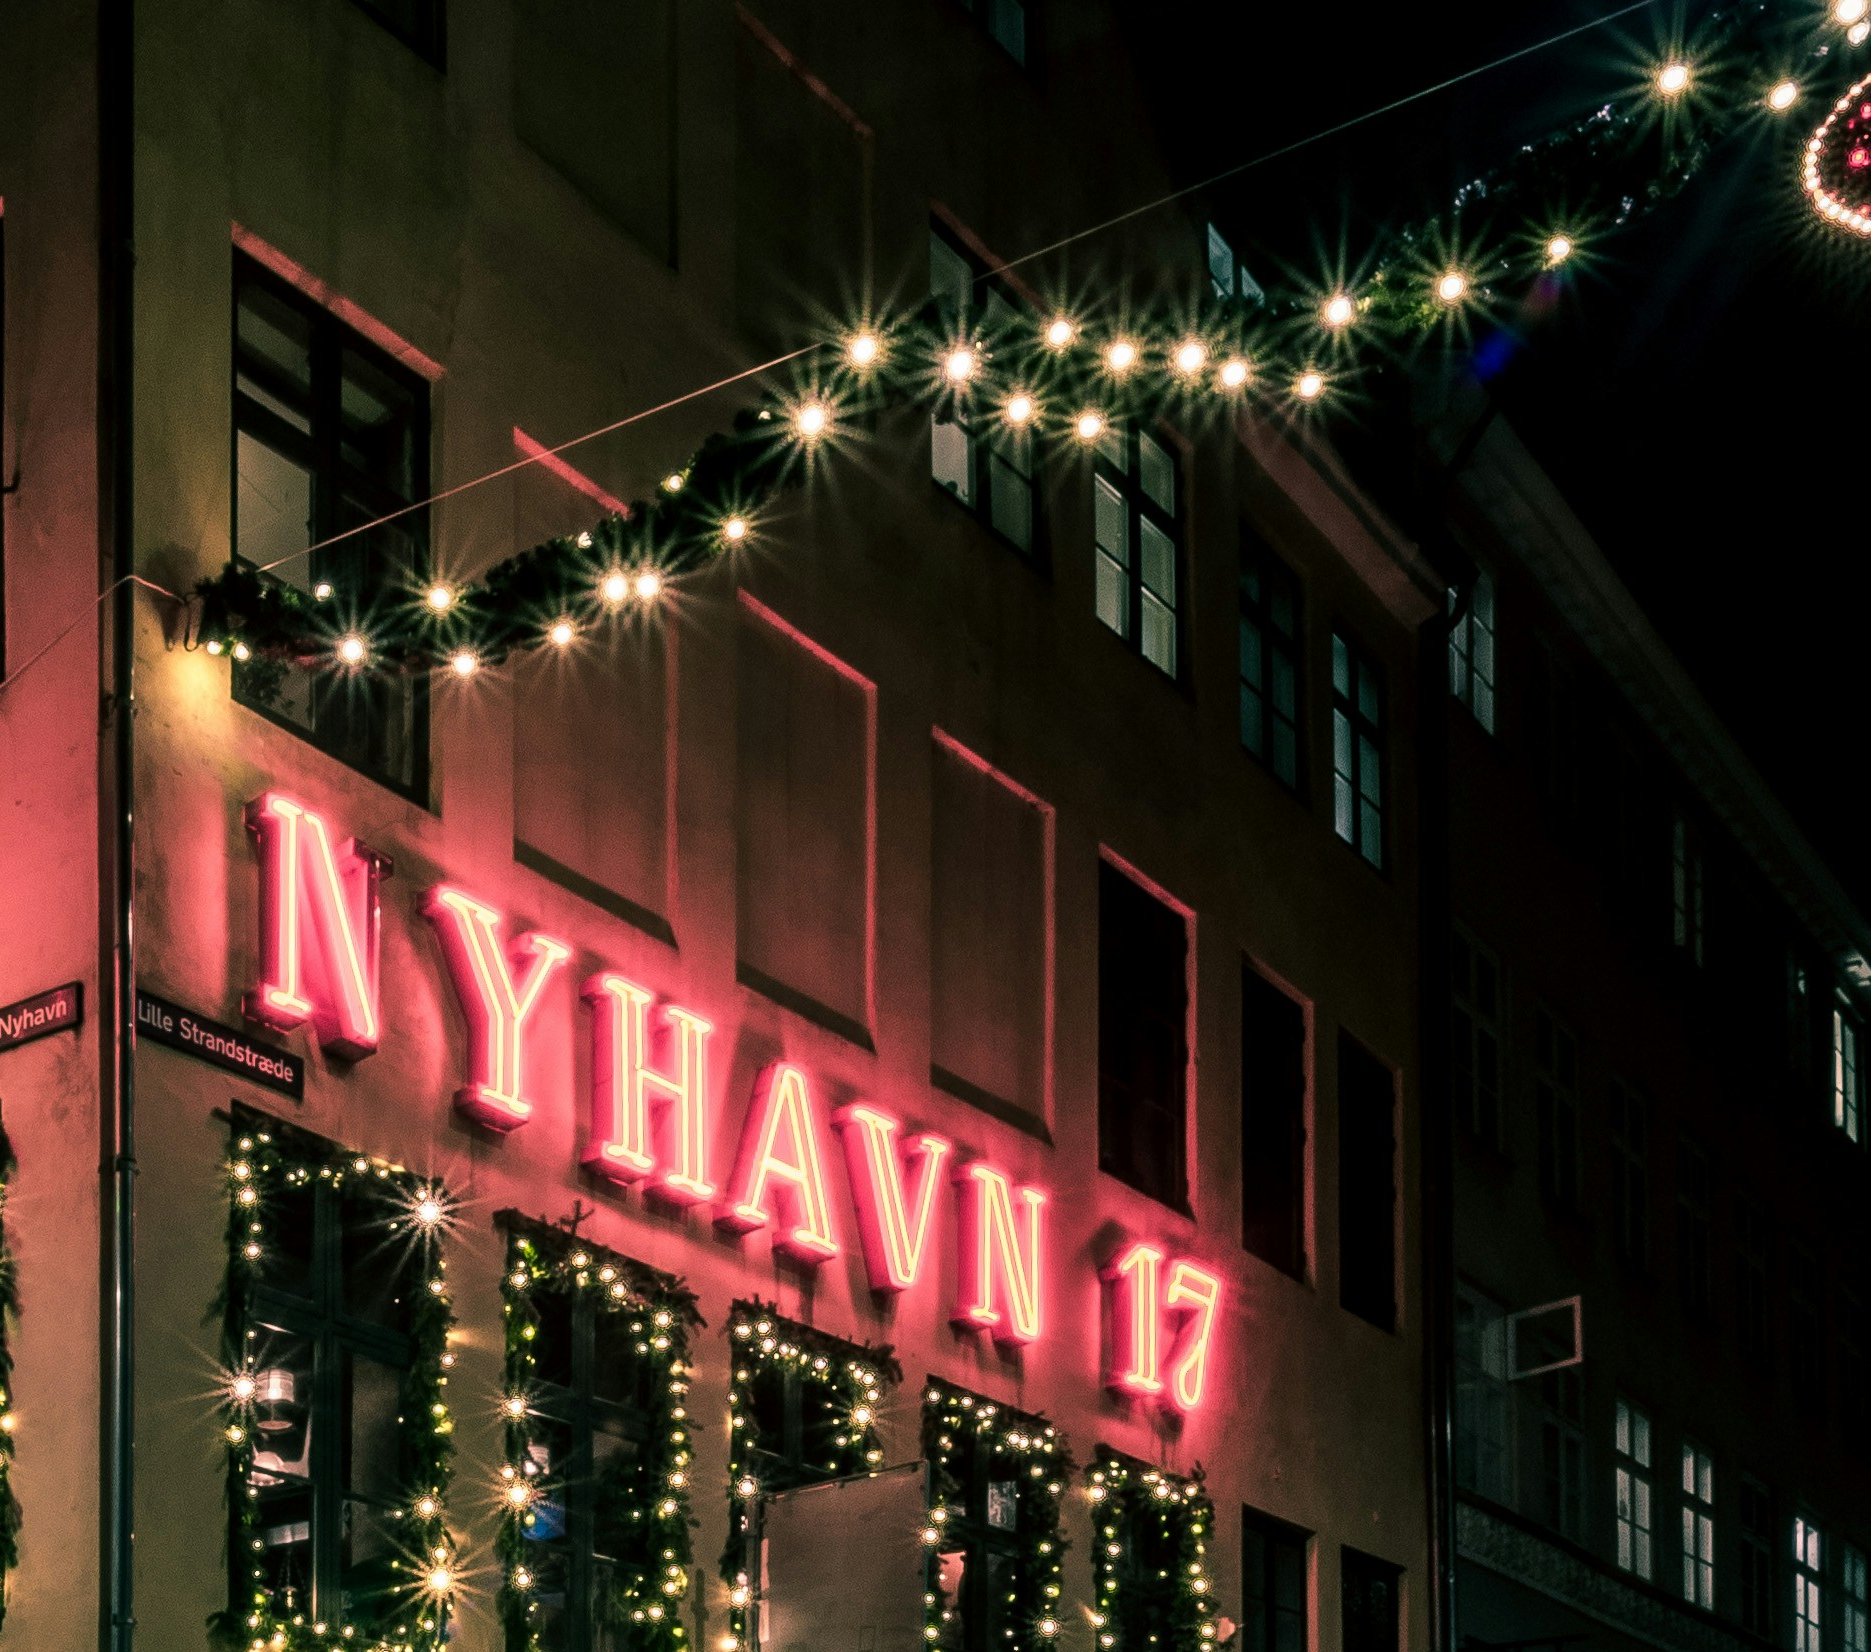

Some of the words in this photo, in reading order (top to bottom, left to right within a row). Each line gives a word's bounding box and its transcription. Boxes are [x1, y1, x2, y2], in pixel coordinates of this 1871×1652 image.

[138, 998, 174, 1032] Lille
[179, 1016, 295, 1084] Strandstræde
[249, 792, 1048, 1347] NYHAVN
[1108, 1243, 1225, 1411] 17
